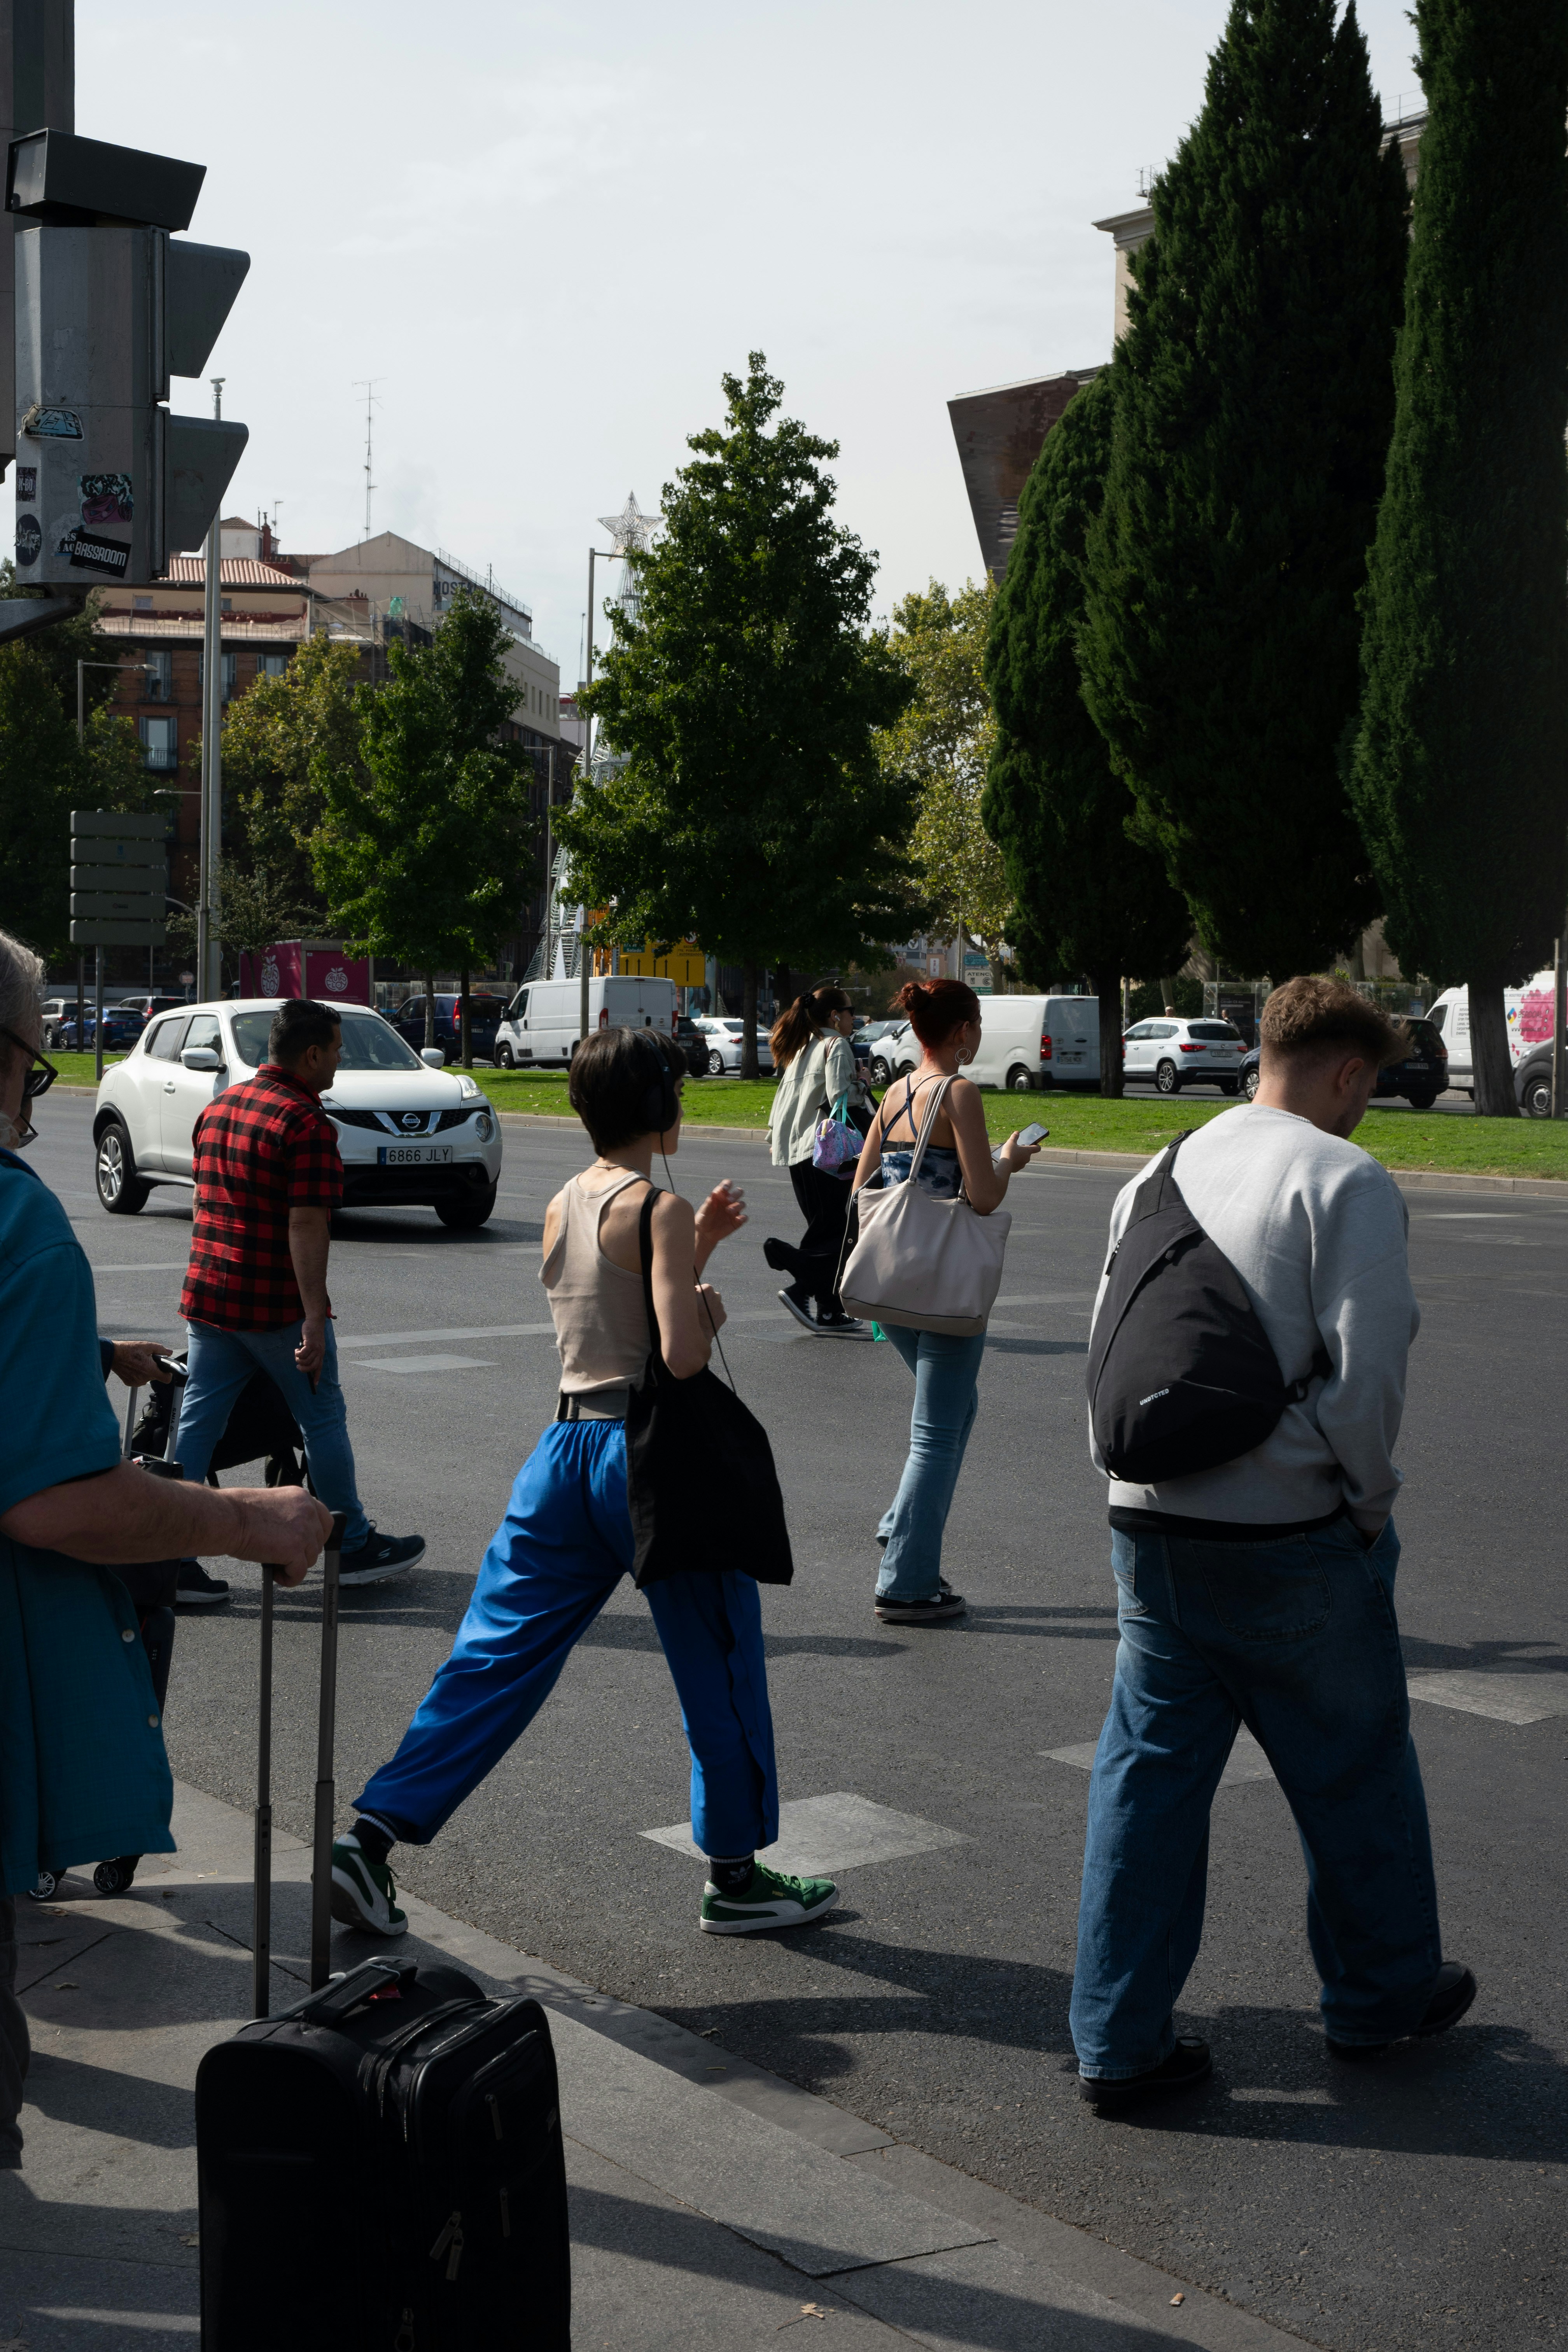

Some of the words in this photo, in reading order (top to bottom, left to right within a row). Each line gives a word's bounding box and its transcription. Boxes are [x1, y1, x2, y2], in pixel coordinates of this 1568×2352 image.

[74, 541, 127, 567] BASSROOM
[327, 973, 346, 983] FRUTAS
[326, 980, 347, 990] ELOY
[389, 1150, 421, 1162] 6866
[426, 1149, 449, 1162] JLY
[1139, 1388, 1170, 1406] UNDTCTED
